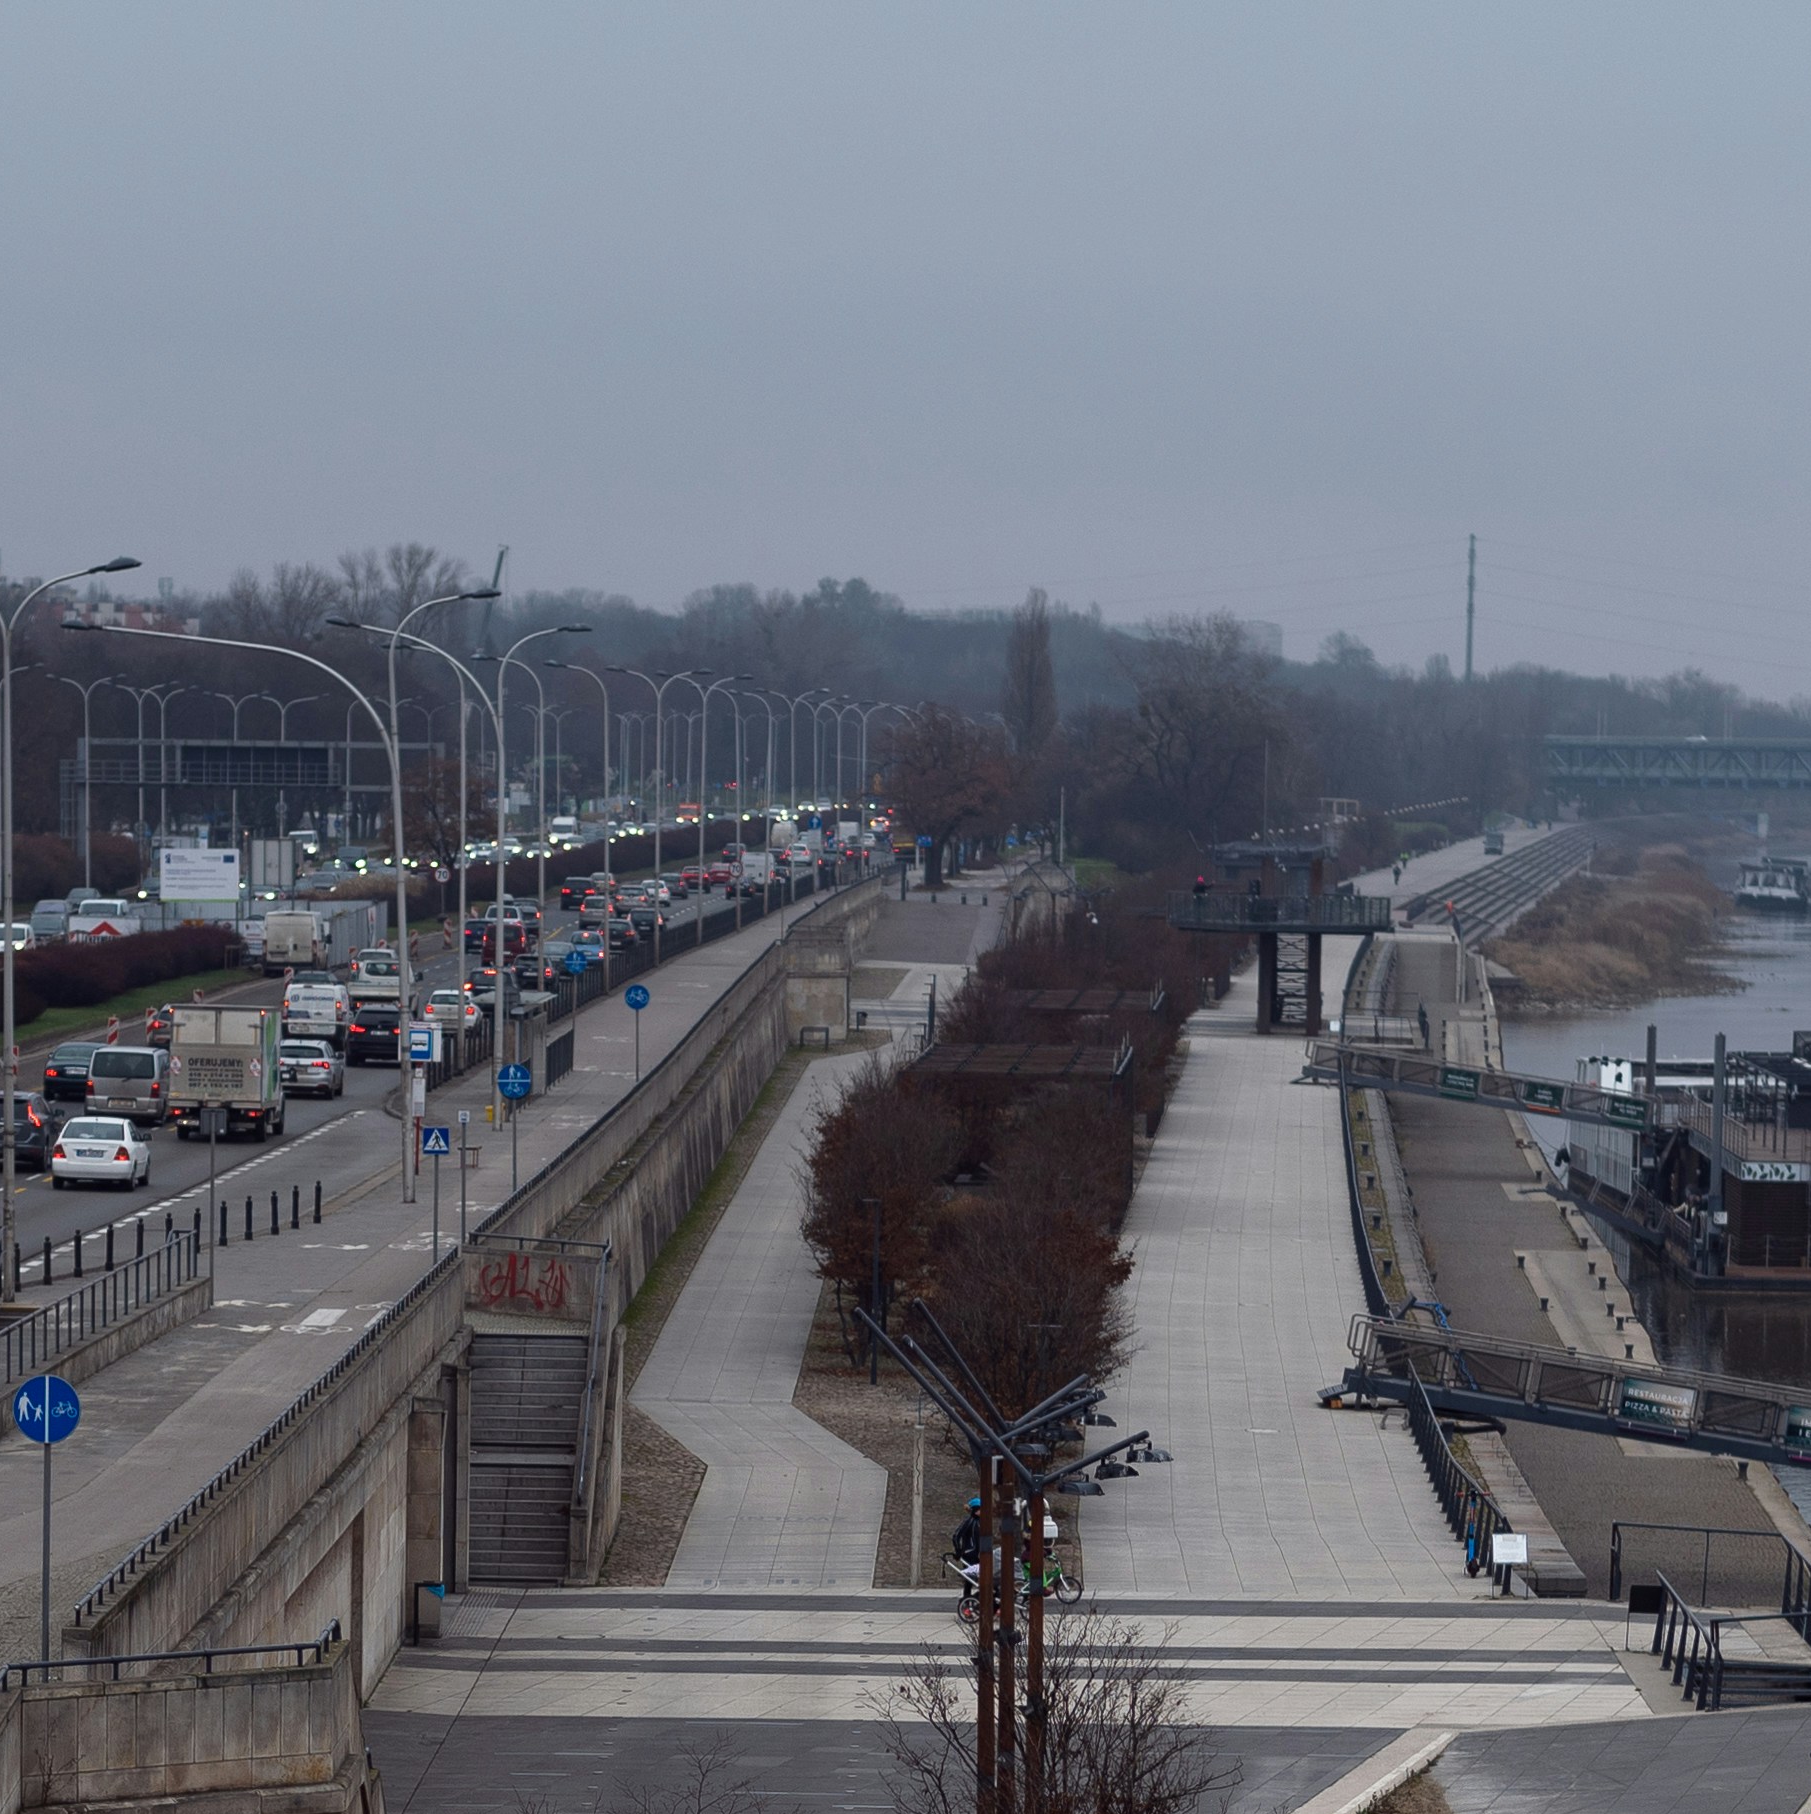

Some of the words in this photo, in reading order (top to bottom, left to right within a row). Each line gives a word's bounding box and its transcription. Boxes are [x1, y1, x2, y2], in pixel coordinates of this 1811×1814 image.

[438, 870, 448, 879] 70
[1628, 1388, 1688, 1405] RESTAURACJA
[1625, 1401, 1649, 1411] PIZZA
[1651, 1405, 1658, 1413] &
[1660, 1407, 1689, 1419] PASTA
